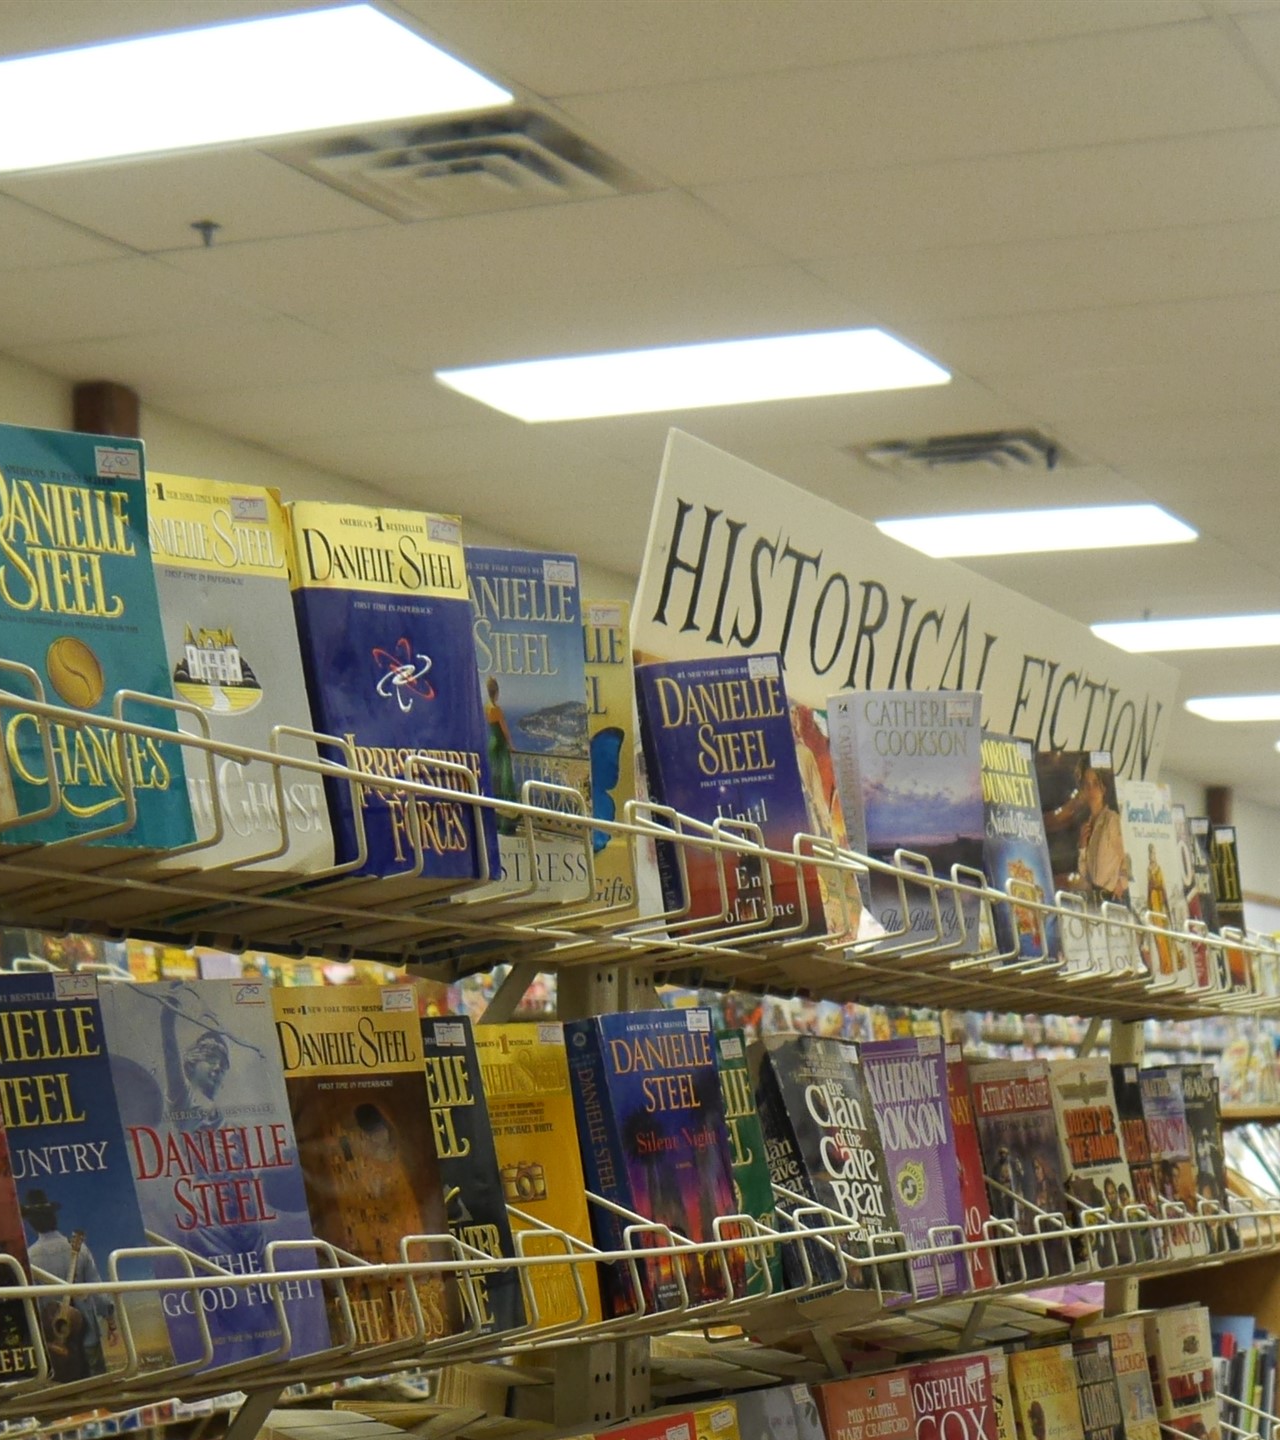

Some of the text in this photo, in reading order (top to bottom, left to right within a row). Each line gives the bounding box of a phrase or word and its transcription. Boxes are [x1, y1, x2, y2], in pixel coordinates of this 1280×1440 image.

[212, 509, 285, 568] STEEL
[339, 518, 424, 534] AMERICA'S BESTSELLER
[302, 527, 464, 590] DANIELLE STEEL
[397, 605, 433, 615] PAPERBACK!
[472, 619, 559, 676] STEEL
[652, 498, 1163, 786] HISTORICAL FICTION
[655, 675, 784, 729] DANIELLE
[698, 723, 776, 776] STEEL
[874, 728, 969, 758] COOKSON
[593, 877, 632, 904] Gifts
[750, 896, 795, 923] Time
[275, 1016, 417, 1071] DANIELLE STEEL
[610, 1031, 713, 1074] DANIELLE
[642, 1074, 702, 1113] STEEL
[805, 1082, 867, 1131] Clan
[826, 1078, 844, 1096] the
[126, 1123, 294, 1181] DANIELLE
[635, 1128, 718, 1156] Silent Night
[845, 1128, 862, 1148] the
[820, 1136, 880, 1182] Cave
[173, 1176, 277, 1232] STEEL
[828, 1178, 887, 1223] Bear
[215, 1250, 263, 1276] THE
[162, 1286, 239, 1318] GOOD
[866, 1403, 898, 1418] MARTHA
[866, 1417, 910, 1438] CRAWFORD
